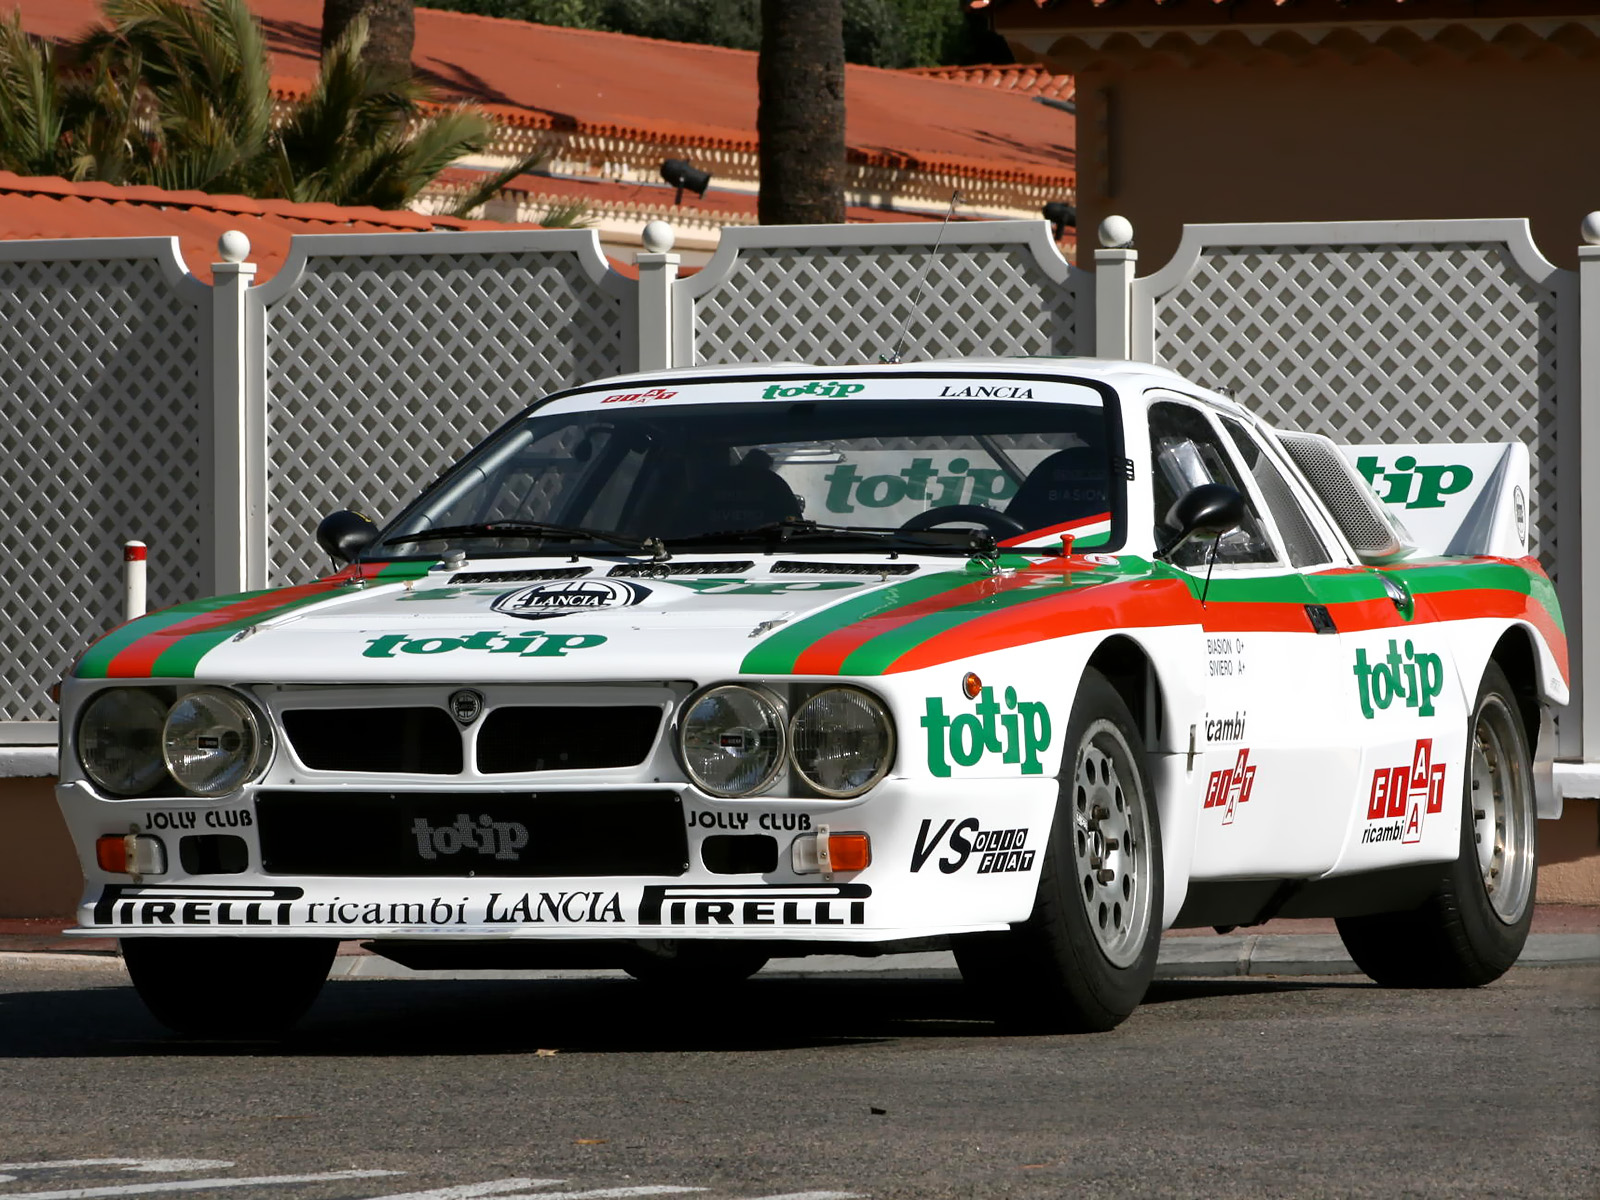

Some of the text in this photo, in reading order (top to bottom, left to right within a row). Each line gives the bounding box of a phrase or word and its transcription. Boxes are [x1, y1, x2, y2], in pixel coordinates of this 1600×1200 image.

[602, 388, 678, 403] FIAT
[761, 380, 866, 400] totip
[938, 385, 1035, 400] LANCIA
[823, 457, 1020, 514] totip
[529, 594, 600, 607] LANCIA
[362, 630, 608, 658] totip
[1207, 638, 1233, 655] BIASION
[1209, 660, 1246, 677] SIVIERO A+
[1353, 638, 1444, 719] totip
[920, 685, 1052, 778] totip
[1204, 748, 1257, 809] FIAT
[1367, 738, 1446, 820] FIAT
[145, 809, 253, 830] JOLLY CLUB
[688, 811, 811, 831] JOLLY CLUB
[1361, 820, 1405, 844] ricambi
[411, 813, 529, 860] totip
[909, 817, 1029, 875] VS OLIO
[977, 850, 1036, 874] FIAT
[93, 884, 304, 926] PIRELLI
[305, 891, 626, 925] ricambi LANCIA
[638, 884, 872, 925] PIRELLI
